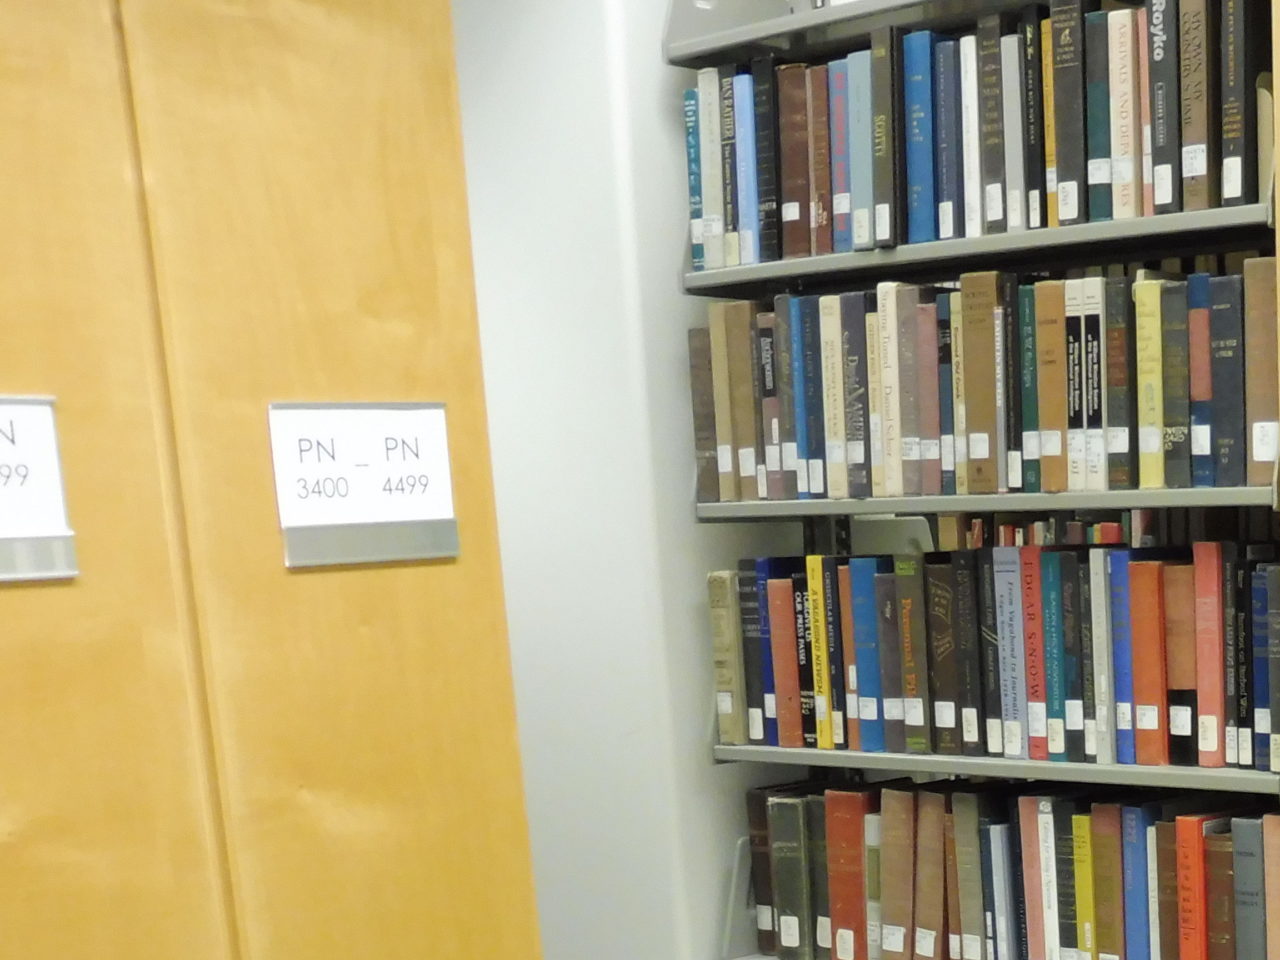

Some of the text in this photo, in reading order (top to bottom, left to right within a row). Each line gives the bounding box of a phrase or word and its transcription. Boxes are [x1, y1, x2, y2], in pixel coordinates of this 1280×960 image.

[1151, 0, 1167, 61] Royko
[1119, 23, 1128, 85] ARRIVALS
[722, 78, 734, 138] DAN RATHER
[1120, 91, 1129, 121] AND
[874, 114, 886, 157] SCOTTY
[883, 335, 891, 369] Tuned
[883, 385, 894, 422] Daniel
[298, 437, 419, 463] PN PN
[297, 474, 429, 499] 3400 4499
[798, 639, 806, 665] PASSES
[901, 598, 914, 667] Personal
[1007, 610, 1016, 660] Vagabond
